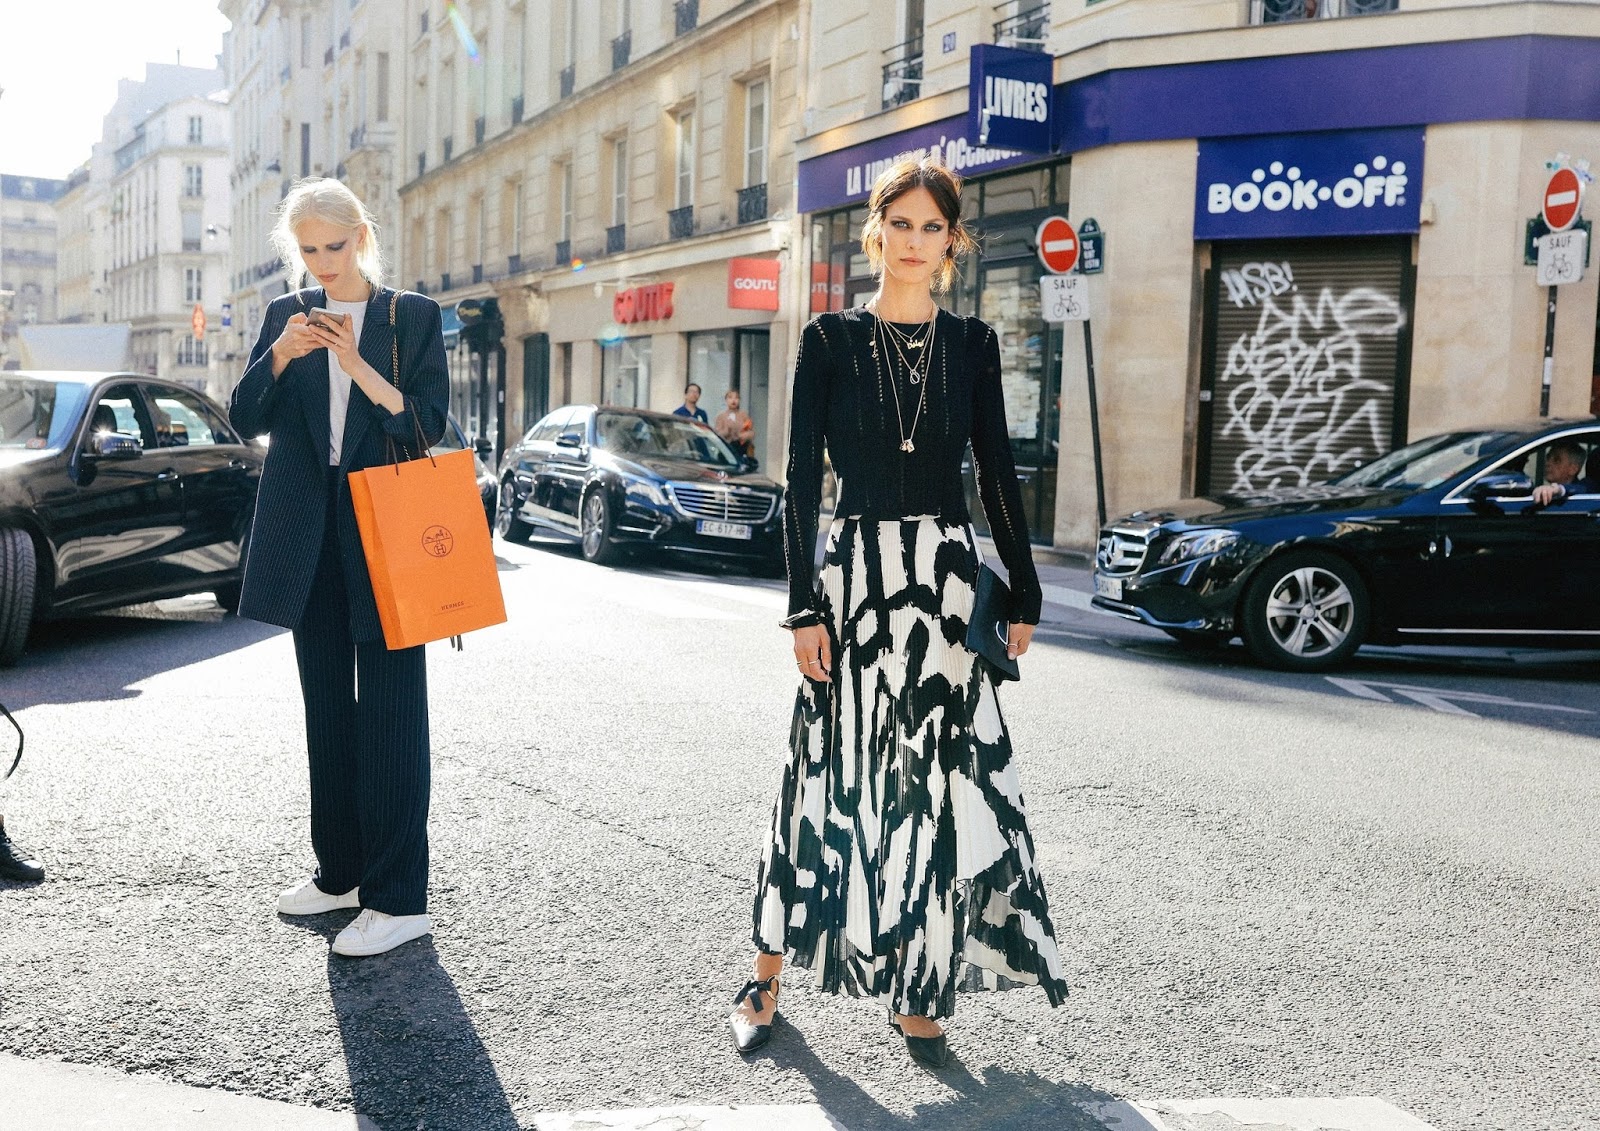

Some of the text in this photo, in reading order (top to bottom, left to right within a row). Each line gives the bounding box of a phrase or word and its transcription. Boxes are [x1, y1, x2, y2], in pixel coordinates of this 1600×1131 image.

[984, 75, 1048, 123] LIVRES
[846, 165, 862, 197] LA
[1549, 236, 1572, 249] SAUF
[1053, 279, 1077, 290] SAUF
